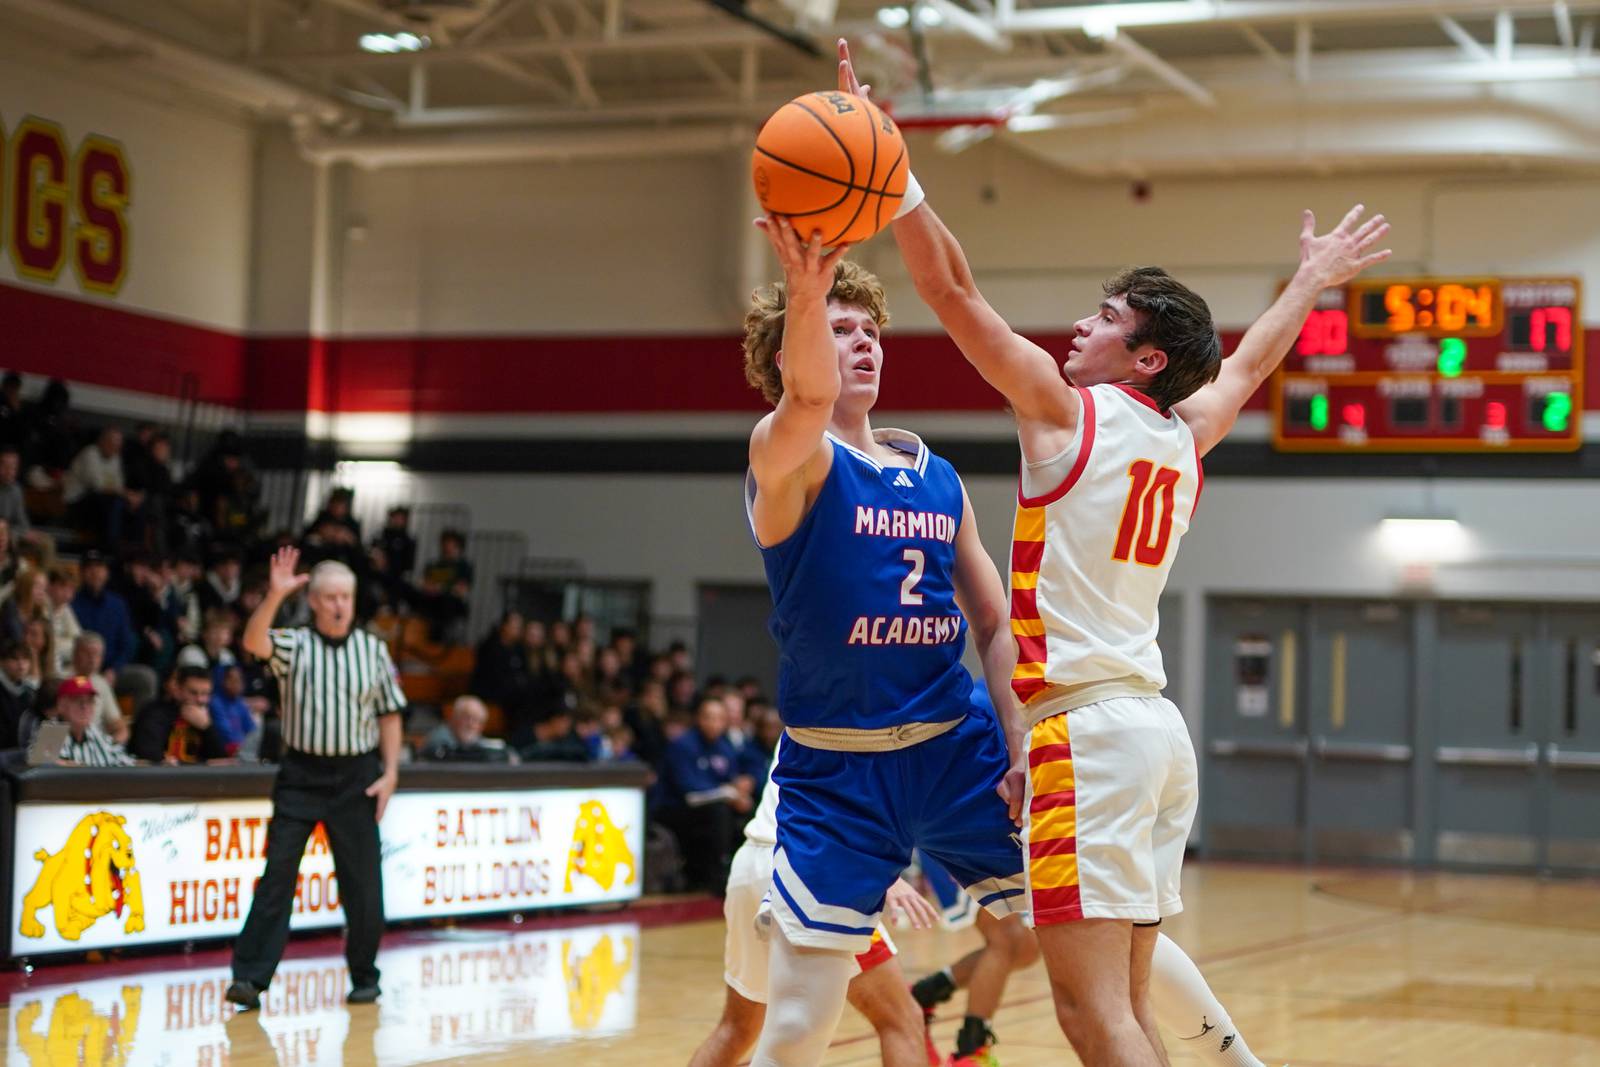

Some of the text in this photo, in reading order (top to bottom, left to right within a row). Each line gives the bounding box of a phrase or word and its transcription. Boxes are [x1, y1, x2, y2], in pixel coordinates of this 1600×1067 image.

[0, 112, 131, 297] GS
[1385, 284, 1492, 332] 5:04
[1530, 306, 1572, 352] 17
[854, 505, 957, 545] MARMION
[1110, 457, 1182, 569] 10
[900, 548, 926, 606] 2
[848, 615, 961, 646] ACADEMY
[169, 876, 240, 926] HIGH
[423, 858, 550, 905] BULLDOGS
